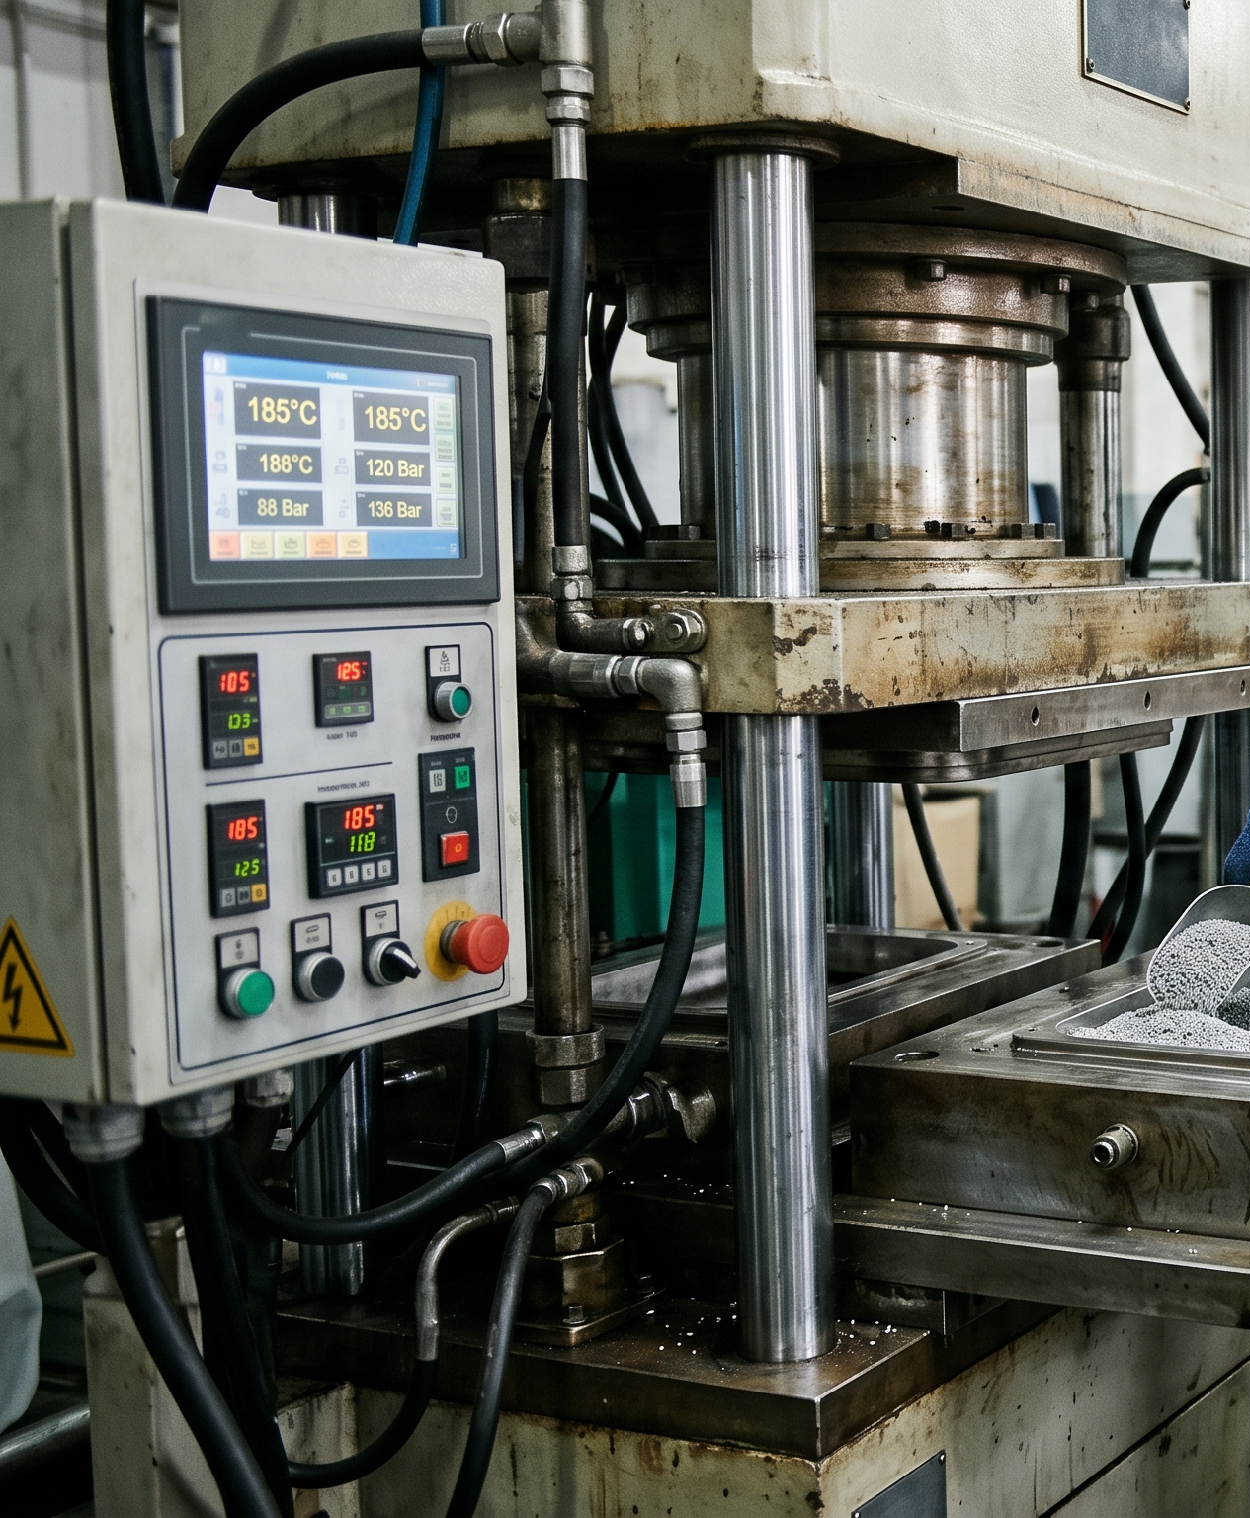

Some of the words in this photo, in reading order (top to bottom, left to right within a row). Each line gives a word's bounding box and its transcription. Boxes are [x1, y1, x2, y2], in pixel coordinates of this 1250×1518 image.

[248, 396, 317, 425] 185°C
[365, 405, 427, 432] 185°C
[260, 453, 313, 474] 188°C
[366, 458, 394, 476] 120
[397, 460, 425, 477] Bar
[257, 498, 278, 516] 88
[282, 499, 309, 517] Bar
[368, 500, 394, 518] 136
[397, 501, 422, 518] Bar
[220, 671, 250, 693] 105
[345, 804, 375, 830] 185
[228, 816, 258, 840] 185
[235, 858, 260, 877] 125
